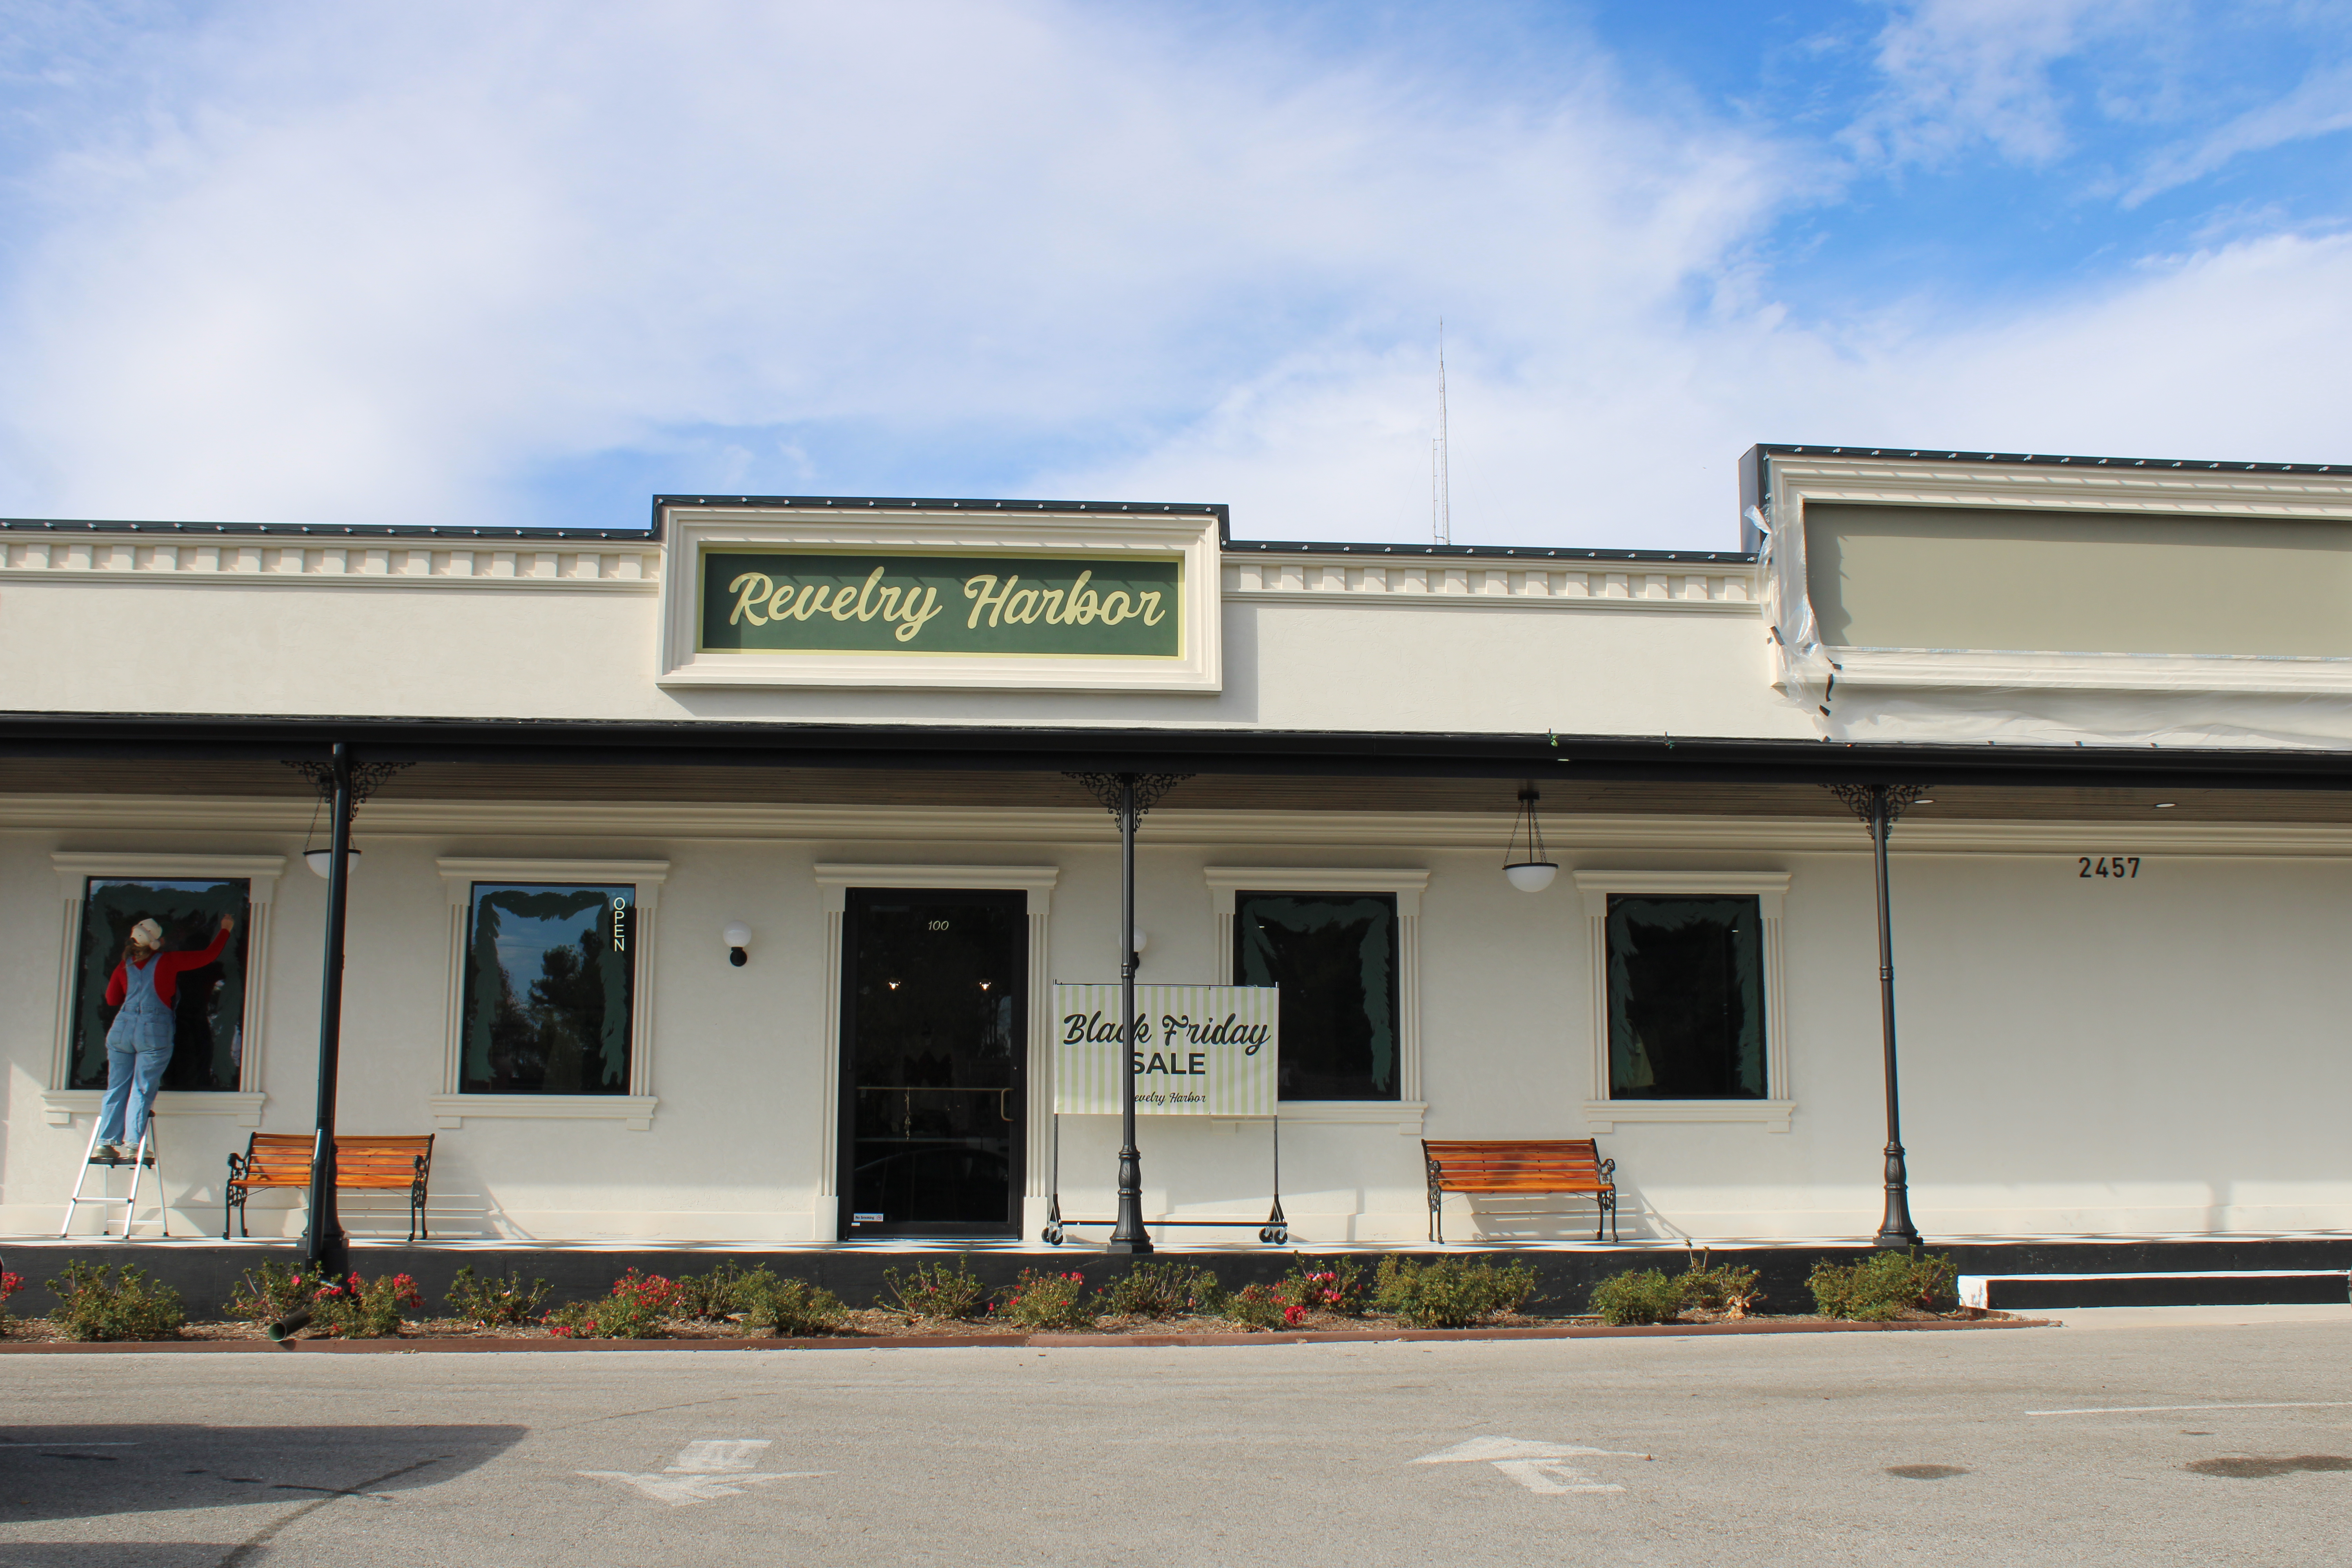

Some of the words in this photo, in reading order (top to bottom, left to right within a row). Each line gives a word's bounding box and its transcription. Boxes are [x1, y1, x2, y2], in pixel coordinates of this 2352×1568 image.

[728, 566, 943, 643] Revelry
[964, 570, 1166, 630] Harbor
[2078, 857, 2140, 878] 2457
[613, 897, 626, 952] OPEN
[928, 920, 949, 931] 100
[1162, 1013, 1271, 1056] Friday
[1134, 1091, 1166, 1106] evelry
[1170, 1091, 1207, 1103] Harbor
